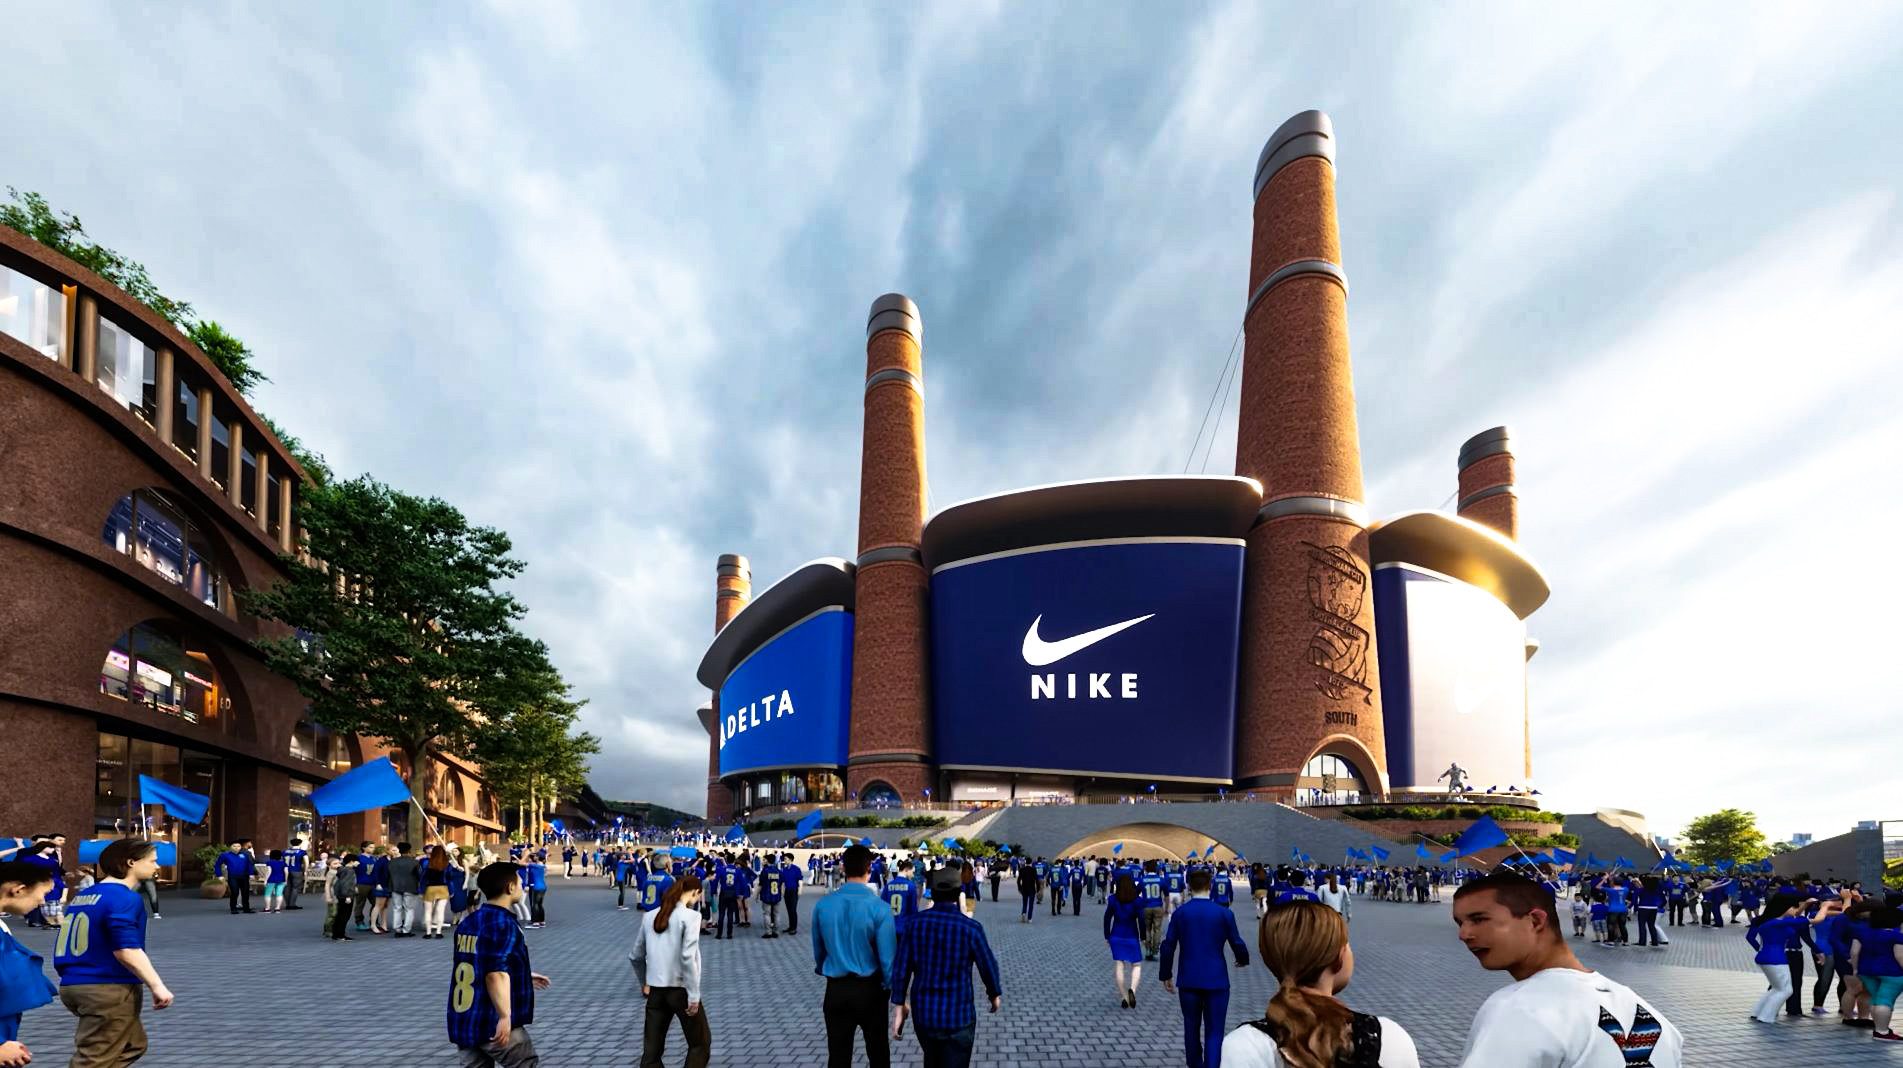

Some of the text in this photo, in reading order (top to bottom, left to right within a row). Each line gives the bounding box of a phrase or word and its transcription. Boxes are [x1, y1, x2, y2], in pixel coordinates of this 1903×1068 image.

[1031, 673, 1138, 700] NIKE
[727, 689, 794, 739] DELTA
[1325, 711, 1357, 726] SOUTH
[725, 873, 735, 886] 8
[770, 880, 779, 895] 8
[1218, 883, 1226, 895] 9
[645, 884, 657, 905] 9
[1145, 883, 1161, 899] 10
[890, 893, 903, 916] 9
[55, 911, 90, 957] 10
[453, 962, 475, 1013] 8
